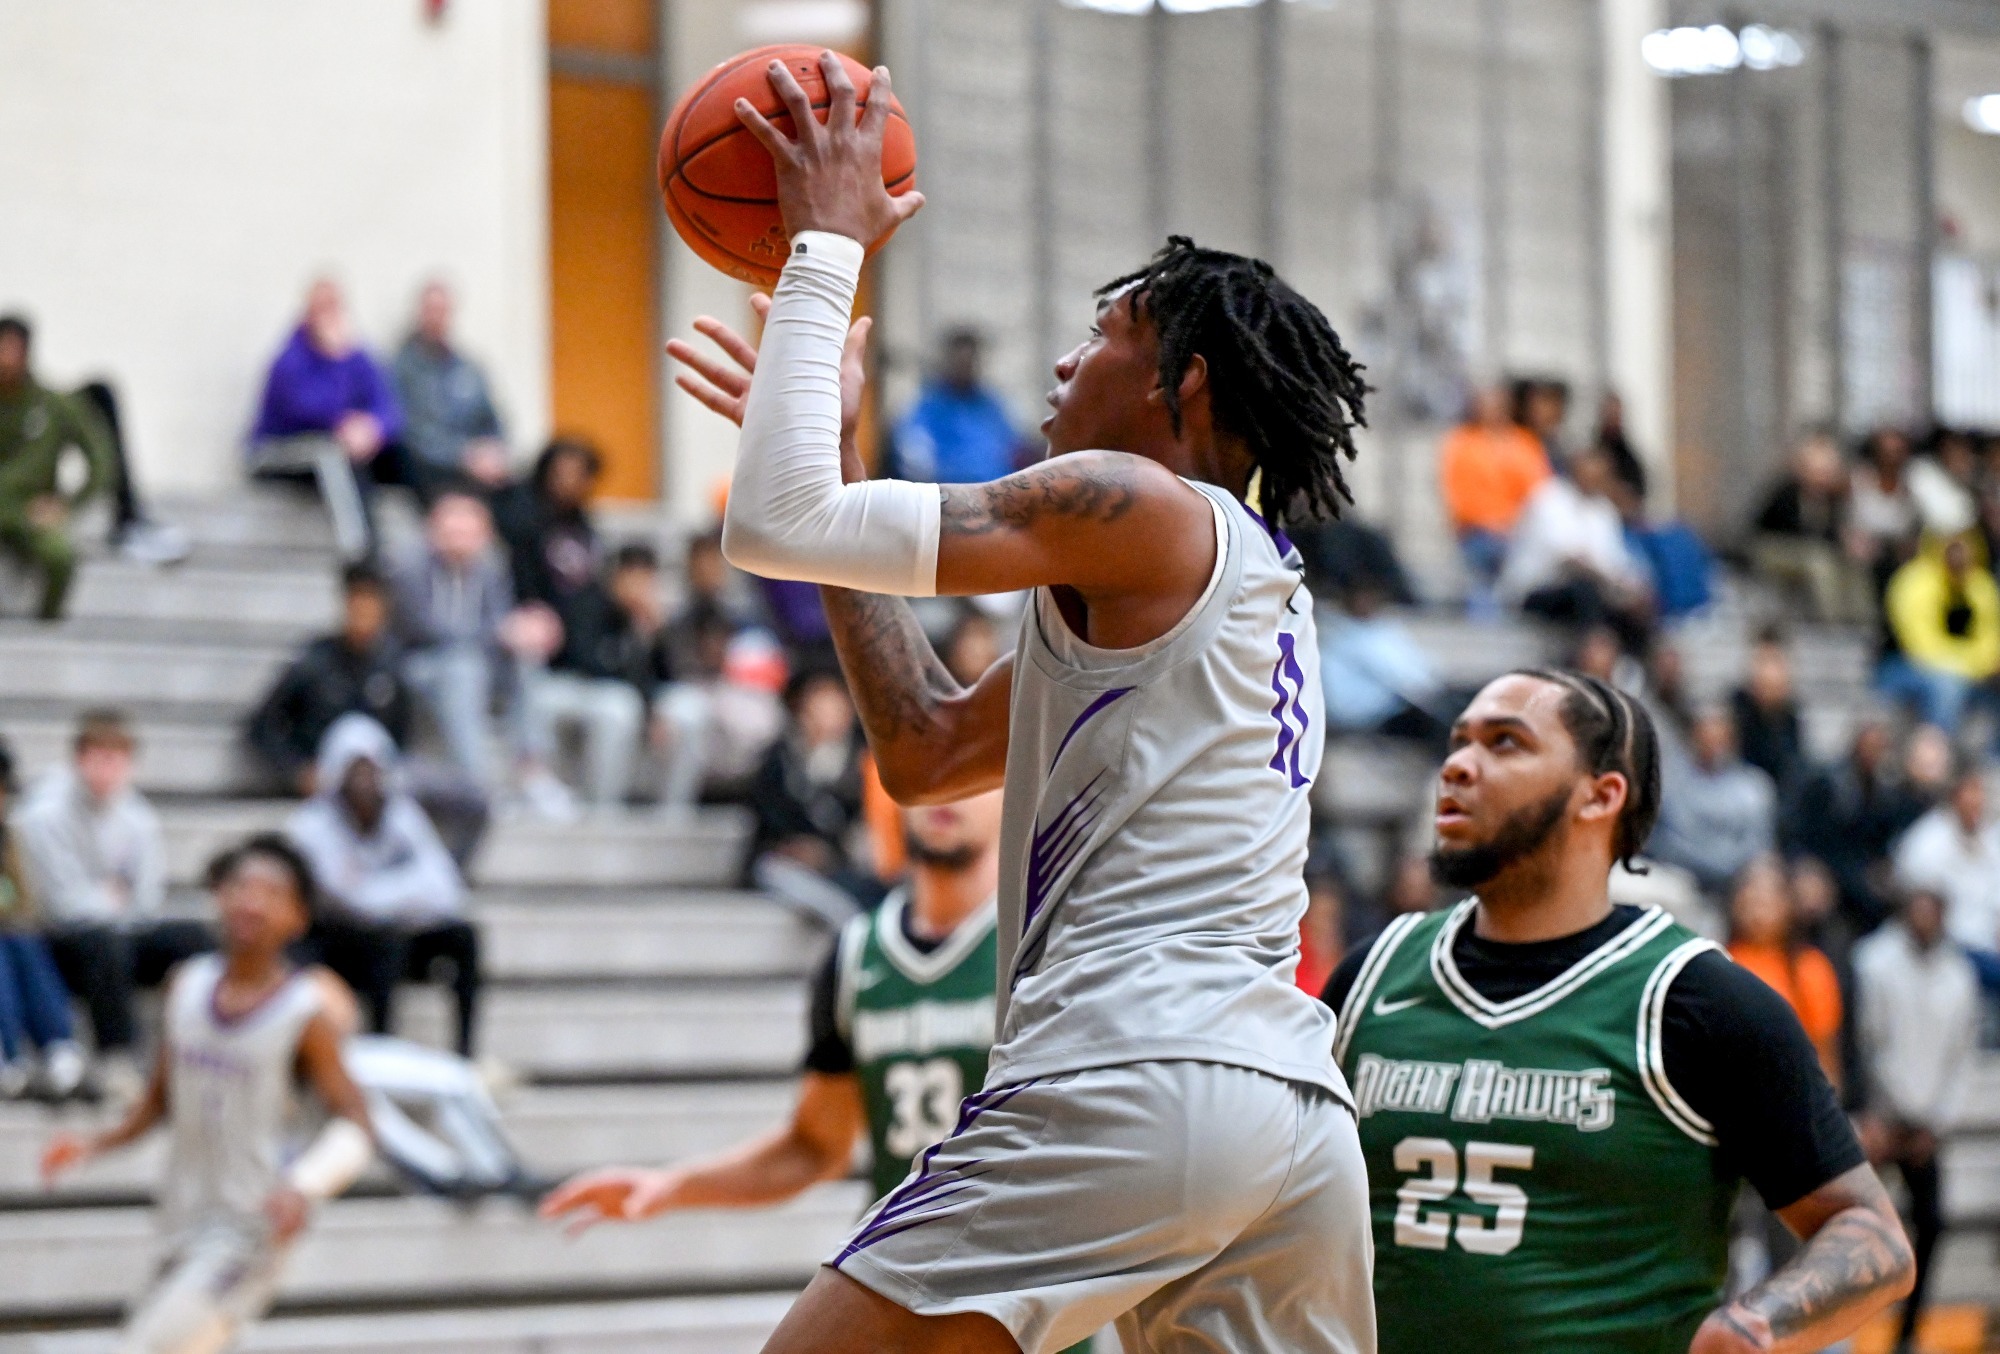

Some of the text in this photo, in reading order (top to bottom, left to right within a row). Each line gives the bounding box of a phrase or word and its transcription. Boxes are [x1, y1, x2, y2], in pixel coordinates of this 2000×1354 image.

[885, 1060, 962, 1158] 33
[1354, 1053, 1616, 1132] NIGHT HAWKS
[1393, 1137, 1534, 1256] 25
